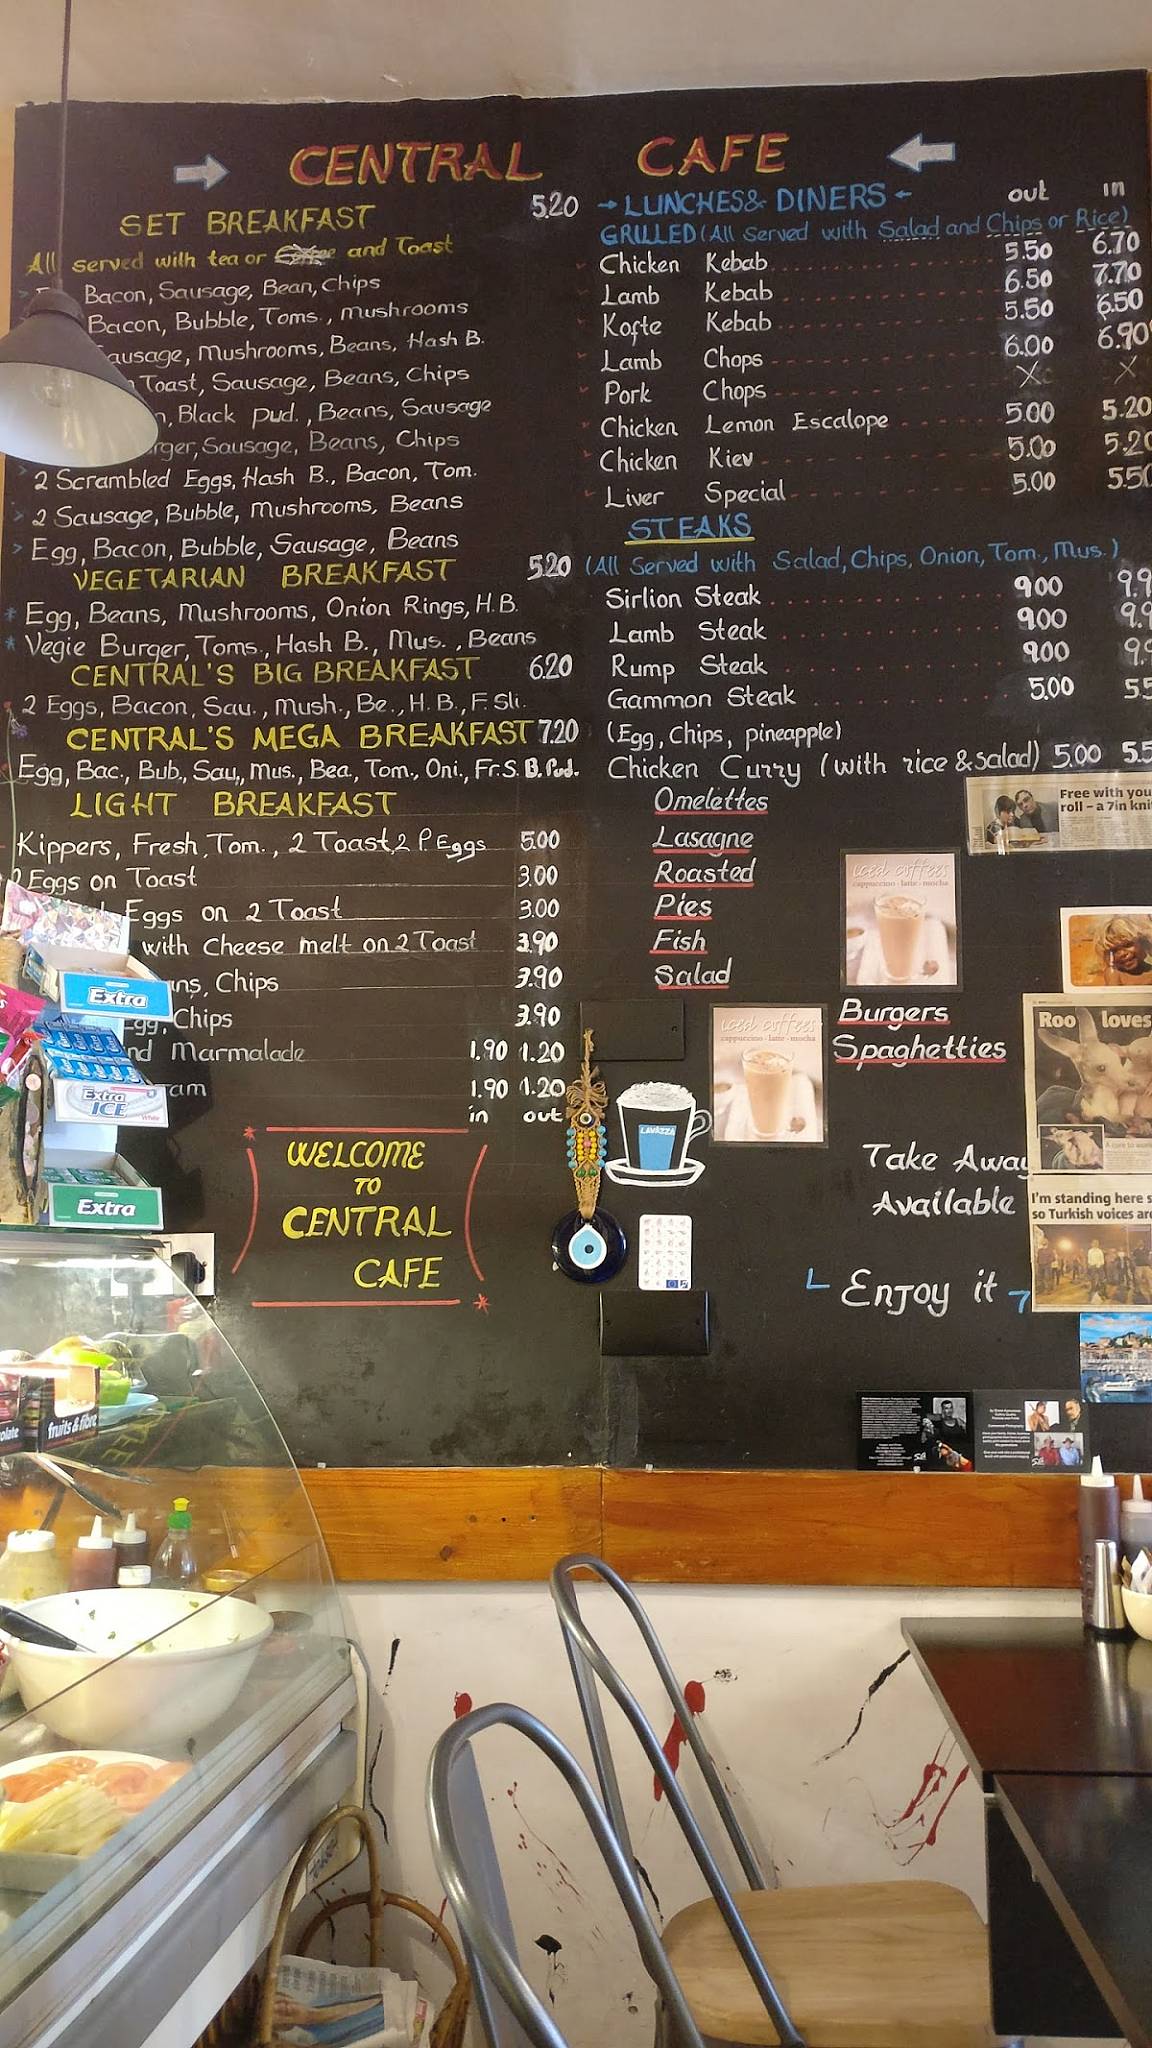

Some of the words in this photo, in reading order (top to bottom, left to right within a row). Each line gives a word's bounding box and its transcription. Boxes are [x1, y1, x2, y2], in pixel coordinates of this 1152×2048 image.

[288, 141, 545, 186] CENTRAL
[637, 132, 791, 177] CAFE
[776, 182, 887, 213] DINERS
[119, 212, 186, 237] SET
[207, 204, 377, 236] BREAKFAST
[878, 215, 940, 238] Salad
[946, 215, 980, 235] and
[986, 213, 1043, 236] Chips
[155, 252, 195, 268] with
[207, 250, 238, 267] tea
[347, 237, 387, 258] and
[395, 233, 453, 256] Toast
[599, 250, 681, 275] Chicken
[706, 249, 768, 274] Kebab
[1005, 240, 1053, 261] 5.50
[1092, 231, 1140, 255] 6.70
[85, 284, 153, 305] Bacon,
[159, 281, 253, 306] Sausage,
[601, 284, 660, 306] Lamb
[705, 280, 774, 303] Kebab
[1005, 268, 1053, 294] 6.50
[88, 315, 167, 336] Bacon,
[175, 310, 255, 331] Bubble,
[706, 309, 772, 332] Kebab
[1005, 297, 1054, 320] 5.50
[407, 331, 458, 349] Hash
[600, 349, 662, 373] Lamb
[703, 345, 763, 373] Chops
[1005, 334, 1054, 358] 6.00
[212, 372, 316, 393] Sausage,
[325, 369, 400, 387] Beans,
[406, 364, 470, 385] Chips
[604, 380, 652, 404] Pork
[703, 378, 767, 407] Chops
[179, 404, 236, 424] Black
[401, 398, 492, 418] Sausage
[600, 415, 679, 438] Chicken
[704, 414, 775, 435] Lemon
[792, 408, 889, 436] Escalope
[1005, 400, 1055, 425] 5.00
[396, 429, 460, 451] Chips
[600, 447, 678, 472] Chicken
[709, 447, 753, 468] Kiev
[56, 468, 171, 490] Scrambled
[242, 466, 294, 488] Hash
[346, 463, 418, 483] Bacon,
[604, 485, 664, 508] Liver
[704, 479, 786, 508] Special
[54, 505, 158, 530] Sausage,
[166, 501, 240, 524] Bubble,
[390, 494, 464, 513] Beans
[627, 512, 752, 541] STEAKS
[93, 537, 173, 561] Bacon,
[180, 538, 263, 561] Bubble,
[387, 527, 459, 550] Beans
[72, 564, 245, 592] VEGETARIAN
[281, 558, 456, 589] BREAKFAST
[711, 551, 756, 573] with
[89, 601, 166, 626] Beans,
[326, 596, 391, 618] Onion
[605, 587, 683, 610] Sirlion
[694, 584, 762, 608] Steak
[609, 621, 675, 644] Lamb
[698, 617, 767, 641] Steak
[25, 632, 86, 664] Vegie
[276, 632, 332, 654] Hash
[468, 629, 536, 649] Beans
[71, 662, 235, 688] CENTRAL'S
[254, 662, 302, 685] BIG
[314, 656, 480, 684] BREAKFAST
[529, 652, 573, 680] 6.20
[611, 653, 676, 684] Rump
[700, 653, 768, 677] Steak
[607, 688, 712, 710] Gammon
[727, 684, 797, 708] Steak
[1028, 676, 1075, 701] 5.00
[66, 725, 235, 752] CENTRAL'S
[252, 723, 341, 752] MEGA
[360, 719, 534, 749] BREAKFAST
[538, 718, 579, 744] 7.20
[607, 755, 699, 780] Chicken
[720, 754, 801, 789] Curry
[902, 749, 948, 774] rice
[70, 792, 178, 818] LIGHT
[214, 791, 397, 817] BREAKFAST
[654, 786, 769, 812] Omelettes
[1060, 789, 1090, 799] Free
[1093, 786, 1123, 798] with
[1060, 801, 1083, 812] roll
[132, 831, 198, 855] Fresh
[652, 825, 754, 857] Lasagne
[27, 869, 81, 895] Eggs
[90, 874, 117, 891] on
[126, 866, 198, 888] Toast
[654, 857, 757, 883] Roasted
[201, 904, 229, 923] on
[246, 903, 262, 922] 2
[269, 896, 343, 920] Toast
[654, 893, 713, 917] Pies
[142, 934, 189, 956] with
[363, 937, 389, 954] on
[412, 930, 477, 951] Toast
[653, 928, 707, 951] Fish
[215, 969, 279, 998] Chips
[654, 957, 733, 986] Salad
[88, 987, 148, 1008] Extra
[173, 1006, 233, 1037] Chips
[838, 998, 949, 1031] Burgers
[1038, 1012, 1077, 1028] Roo
[1101, 1010, 1152, 1028] loves
[172, 1039, 305, 1062] Marmalade
[831, 1033, 1007, 1071] Spaghetties
[82, 1089, 126, 1102] Extra
[471, 1078, 508, 1099] 1.90
[91, 1101, 128, 1118] ICE
[468, 1106, 489, 1124] in
[523, 1109, 564, 1123] out
[287, 1140, 426, 1169] WELCOME
[862, 1141, 939, 1171] Take
[354, 1176, 382, 1195] TO
[1031, 1192, 1051, 1204] I'm
[1055, 1192, 1111, 1206] standing
[1115, 1192, 1143, 1204] here
[76, 1198, 137, 1217] Extra
[872, 1186, 1016, 1218] Available
[1032, 1211, 1045, 1219] so
[1048, 1207, 1094, 1220] Turkish
[1097, 1207, 1134, 1219] voices
[282, 1205, 452, 1240] CENTRAL
[353, 1257, 443, 1289] CAFE
[974, 1269, 998, 1303] it
[47, 1419, 72, 1440] fruits
